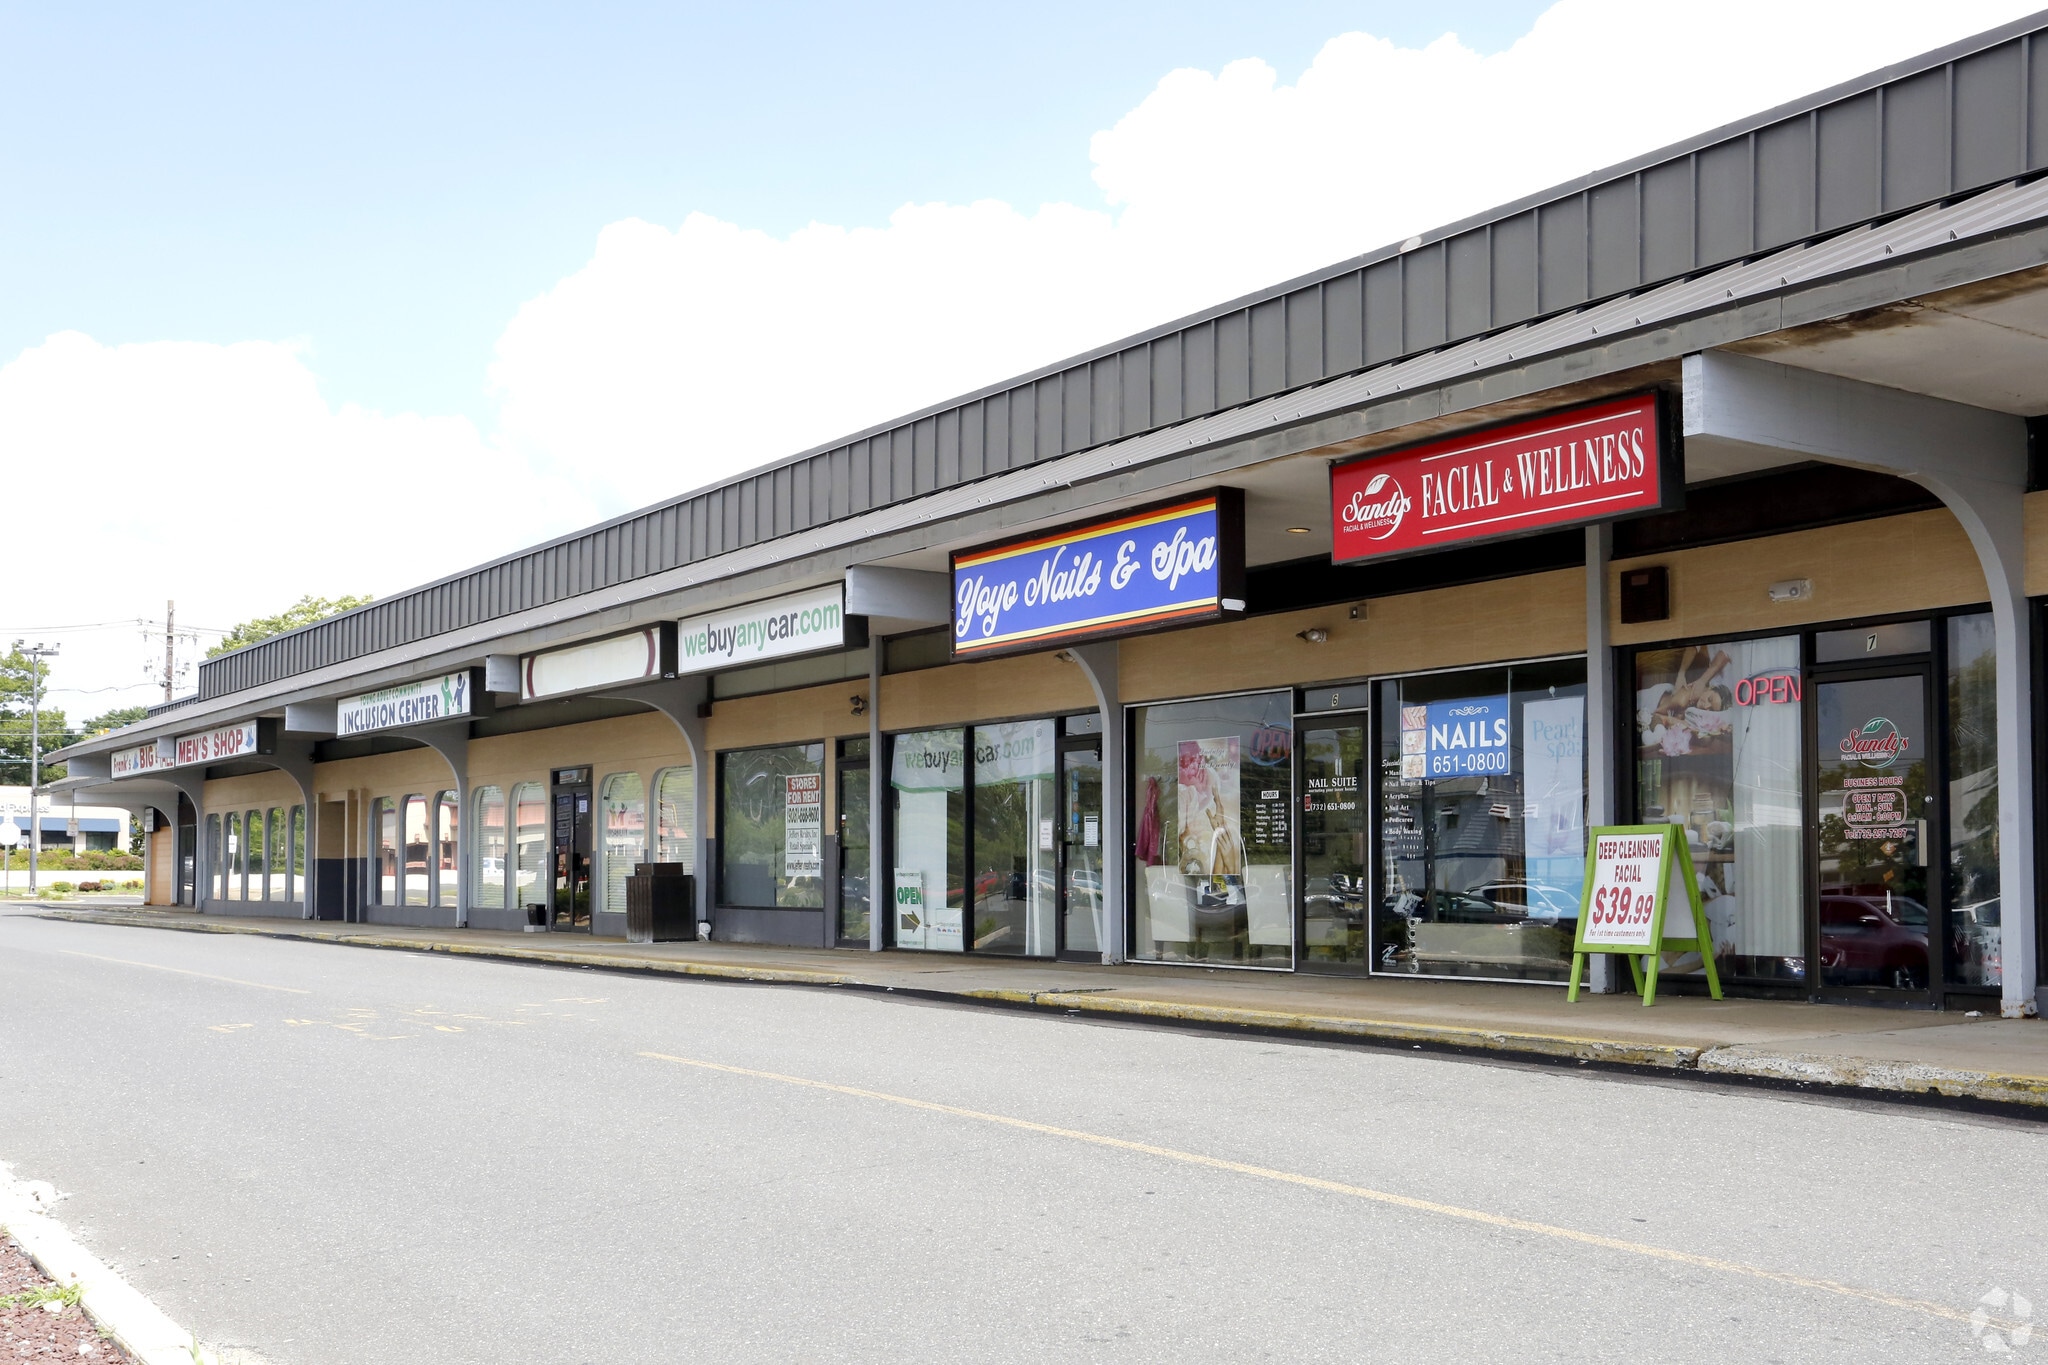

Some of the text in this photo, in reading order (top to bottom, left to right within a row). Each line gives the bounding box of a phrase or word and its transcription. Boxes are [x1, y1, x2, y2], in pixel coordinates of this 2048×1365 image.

[1421, 427, 1645, 519] FACIAL & WELLNESS
[1343, 524, 1360, 533] FACIAL
[1364, 518, 1390, 529] WELLNESS
[956, 526, 1217, 637] Yoyo Nails & Spa
[684, 603, 840, 658] webuyanycar.com
[1868, 635, 1876, 649] 7
[360, 692, 376, 706] YOUNG
[1332, 694, 1339, 706] 6
[1734, 675, 1802, 706] OPEN
[344, 694, 439, 733] INCLUSION CENTER
[1431, 718, 1507, 751] NAILS
[1533, 716, 1576, 741] Pearl
[178, 736, 209, 764] MEN'S
[213, 729, 244, 757] SHOP
[1251, 728, 1292, 759] OPEN
[140, 745, 154, 768] BIG
[1433, 752, 1506, 774] 651-0800
[791, 777, 817, 790] STORES
[1308, 776, 1358, 789] NAIL SUITE
[1843, 776, 1903, 788] BUSINESS HOURS
[787, 790, 820, 803] FOR RENT
[1852, 793, 1896, 803] OPEN 7 DAYS
[1310, 802, 1326, 812] (732)
[1855, 803, 1873, 812] MON.
[1878, 802, 1893, 811] SUN
[1598, 839, 1660, 859] DEEP CLEANSING
[1614, 864, 1642, 882] FACIAL
[896, 886, 922, 905] OPEN
[1592, 884, 1654, 928] $39.99
[1589, 928, 1597, 937] For
[1604, 929, 1613, 937] time
[1614, 929, 1635, 937] customers
